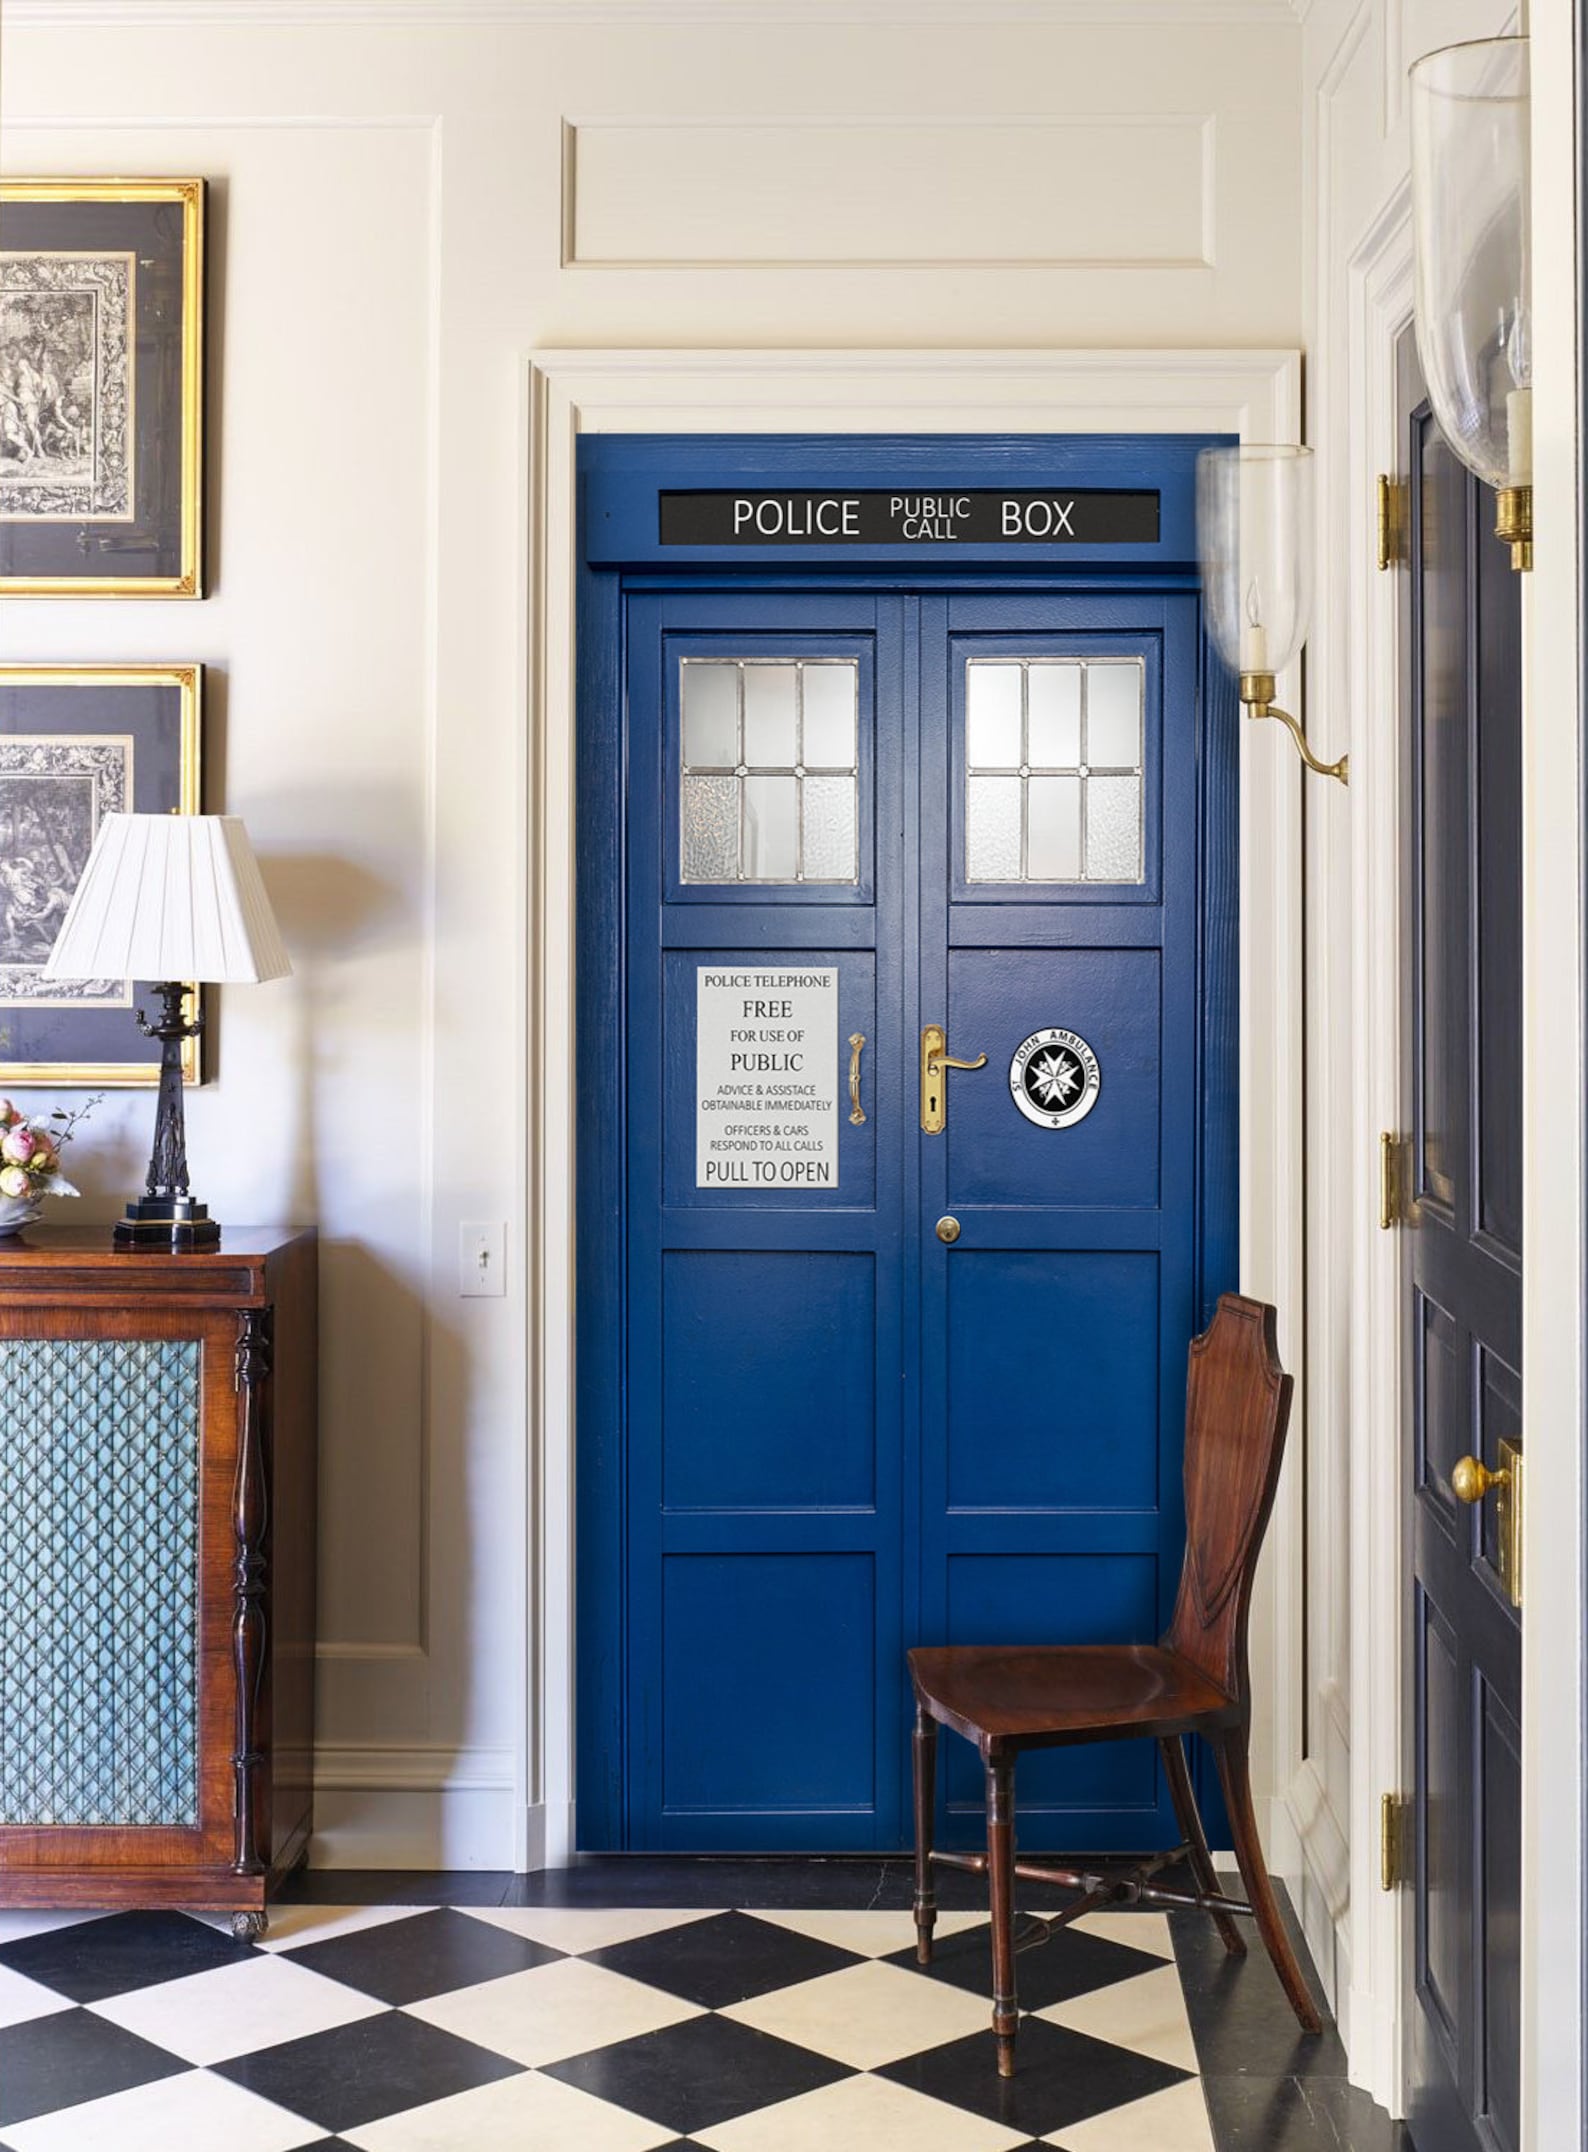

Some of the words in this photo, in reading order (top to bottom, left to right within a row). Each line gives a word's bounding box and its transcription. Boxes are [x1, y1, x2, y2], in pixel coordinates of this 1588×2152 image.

[890, 497, 971, 518] PUBLIC
[733, 499, 860, 535] POLICE
[1001, 500, 1075, 536] BOX
[902, 518, 958, 539] CALL
[704, 975, 751, 988] POLICE
[754, 975, 831, 988] TELEPHONE
[743, 1000, 793, 1018] FREE
[730, 1030, 757, 1042] FOR
[759, 1030, 785, 1042] USE
[787, 1030, 805, 1042] OF
[1015, 1036, 1040, 1066] JOHN
[730, 1053, 804, 1072] PUBLIC
[717, 1084, 753, 1096] ADVICE
[755, 1084, 764, 1096] &
[765, 1084, 816, 1096] ASSISTACE
[701, 1099, 763, 1111] OBTAINABLE
[764, 1099, 832, 1111] IMMEDIATELY
[724, 1125, 771, 1136] OFFICERS
[773, 1125, 782, 1136] &
[783, 1125, 809, 1136] CARS
[710, 1140, 758, 1151] RESPOND
[760, 1140, 773, 1151] TO
[774, 1140, 792, 1151] ALL
[793, 1140, 824, 1151] CALLS
[705, 1161, 749, 1182] PULL
[752, 1161, 777, 1182] TO
[780, 1161, 830, 1182] OPEN
